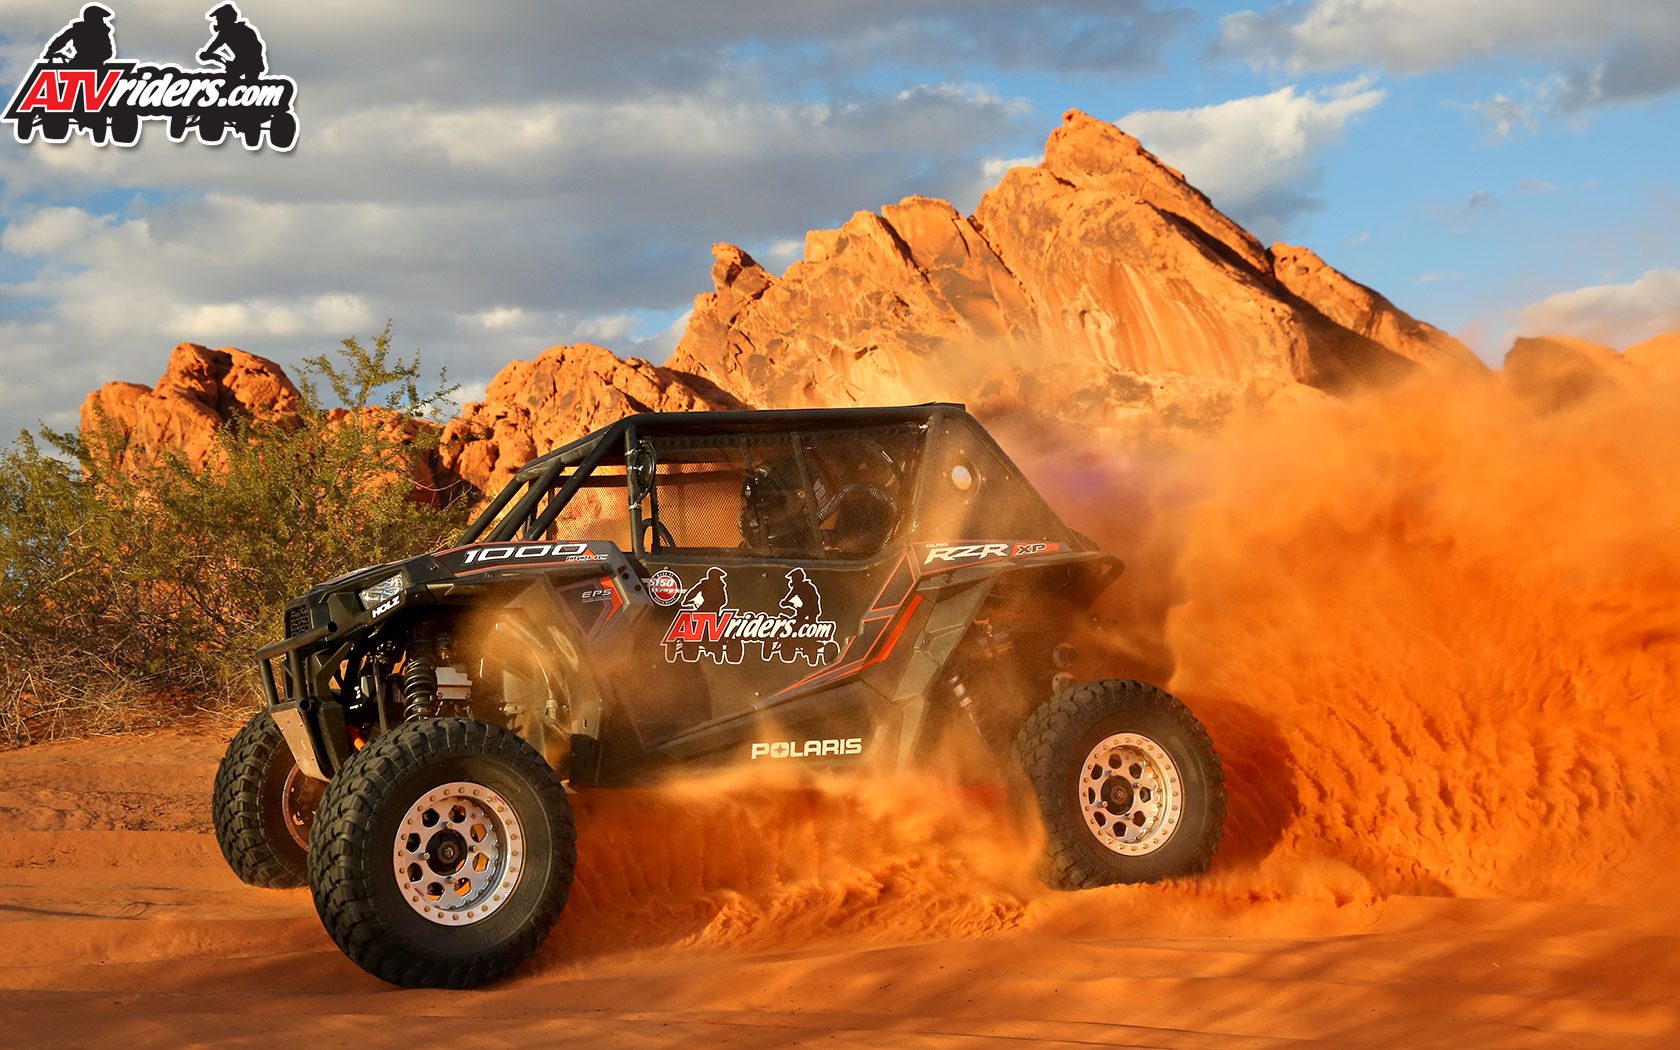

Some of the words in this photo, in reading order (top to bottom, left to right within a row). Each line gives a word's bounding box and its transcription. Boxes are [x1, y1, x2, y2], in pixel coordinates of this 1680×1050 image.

[463, 543, 588, 564] 1000
[923, 543, 1010, 566] RZR
[1014, 543, 1047, 556] XP
[581, 588, 612, 599] EPS
[371, 595, 400, 619] HOLZ
[665, 612, 832, 643] ATVriders.com
[751, 737, 862, 760] POLARIS
